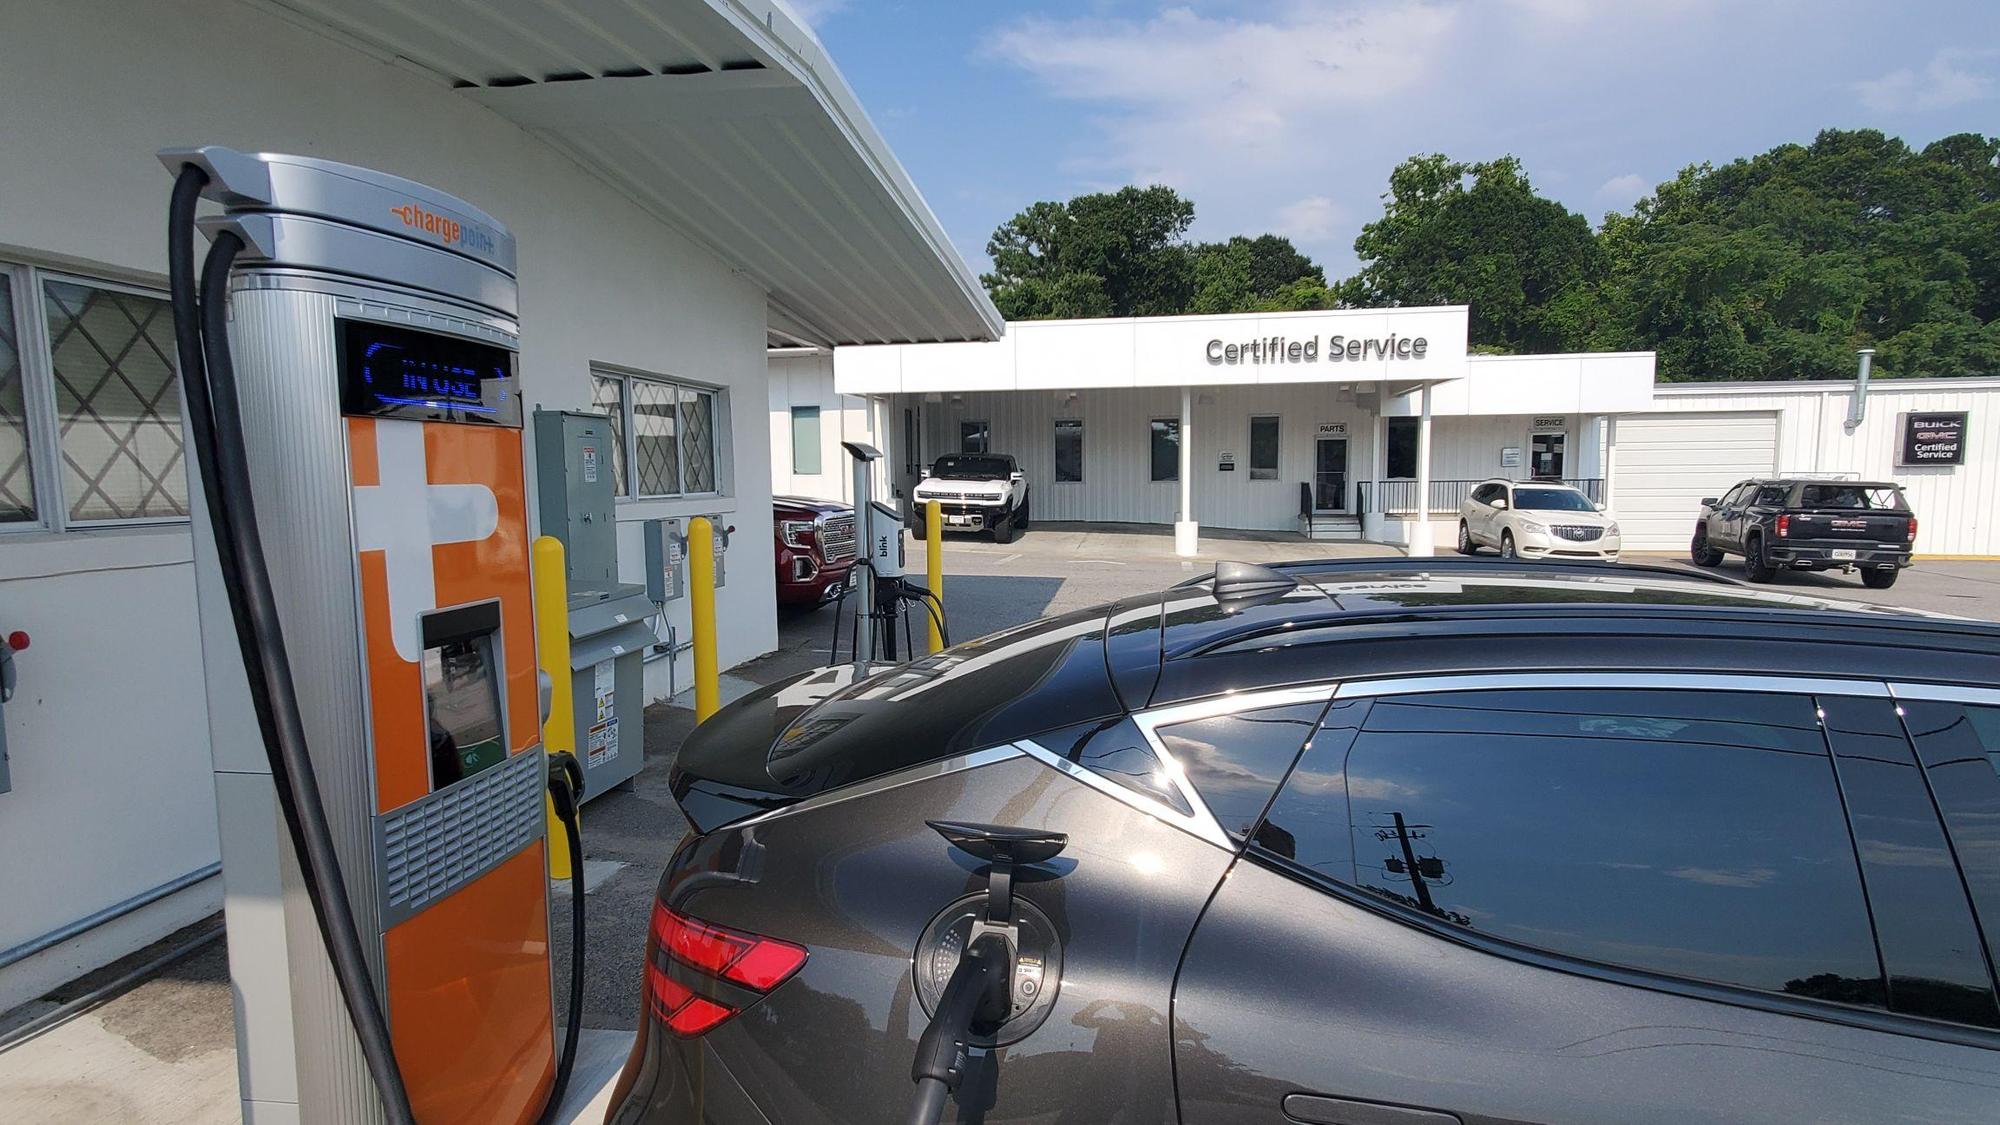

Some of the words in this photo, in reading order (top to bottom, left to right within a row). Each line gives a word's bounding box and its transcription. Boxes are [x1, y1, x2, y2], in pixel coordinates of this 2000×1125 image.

[1206, 335, 1319, 363] Certified
[1329, 333, 1428, 361] Service
[1535, 419, 1563, 427] SERVICE
[1913, 420, 1961, 428] BUICK
[1320, 424, 1345, 433] PARTS
[1916, 431, 1958, 440] GMC
[1914, 442, 1958, 451] Certified
[1916, 450, 1953, 459] Service
[879, 535, 888, 558] blink
